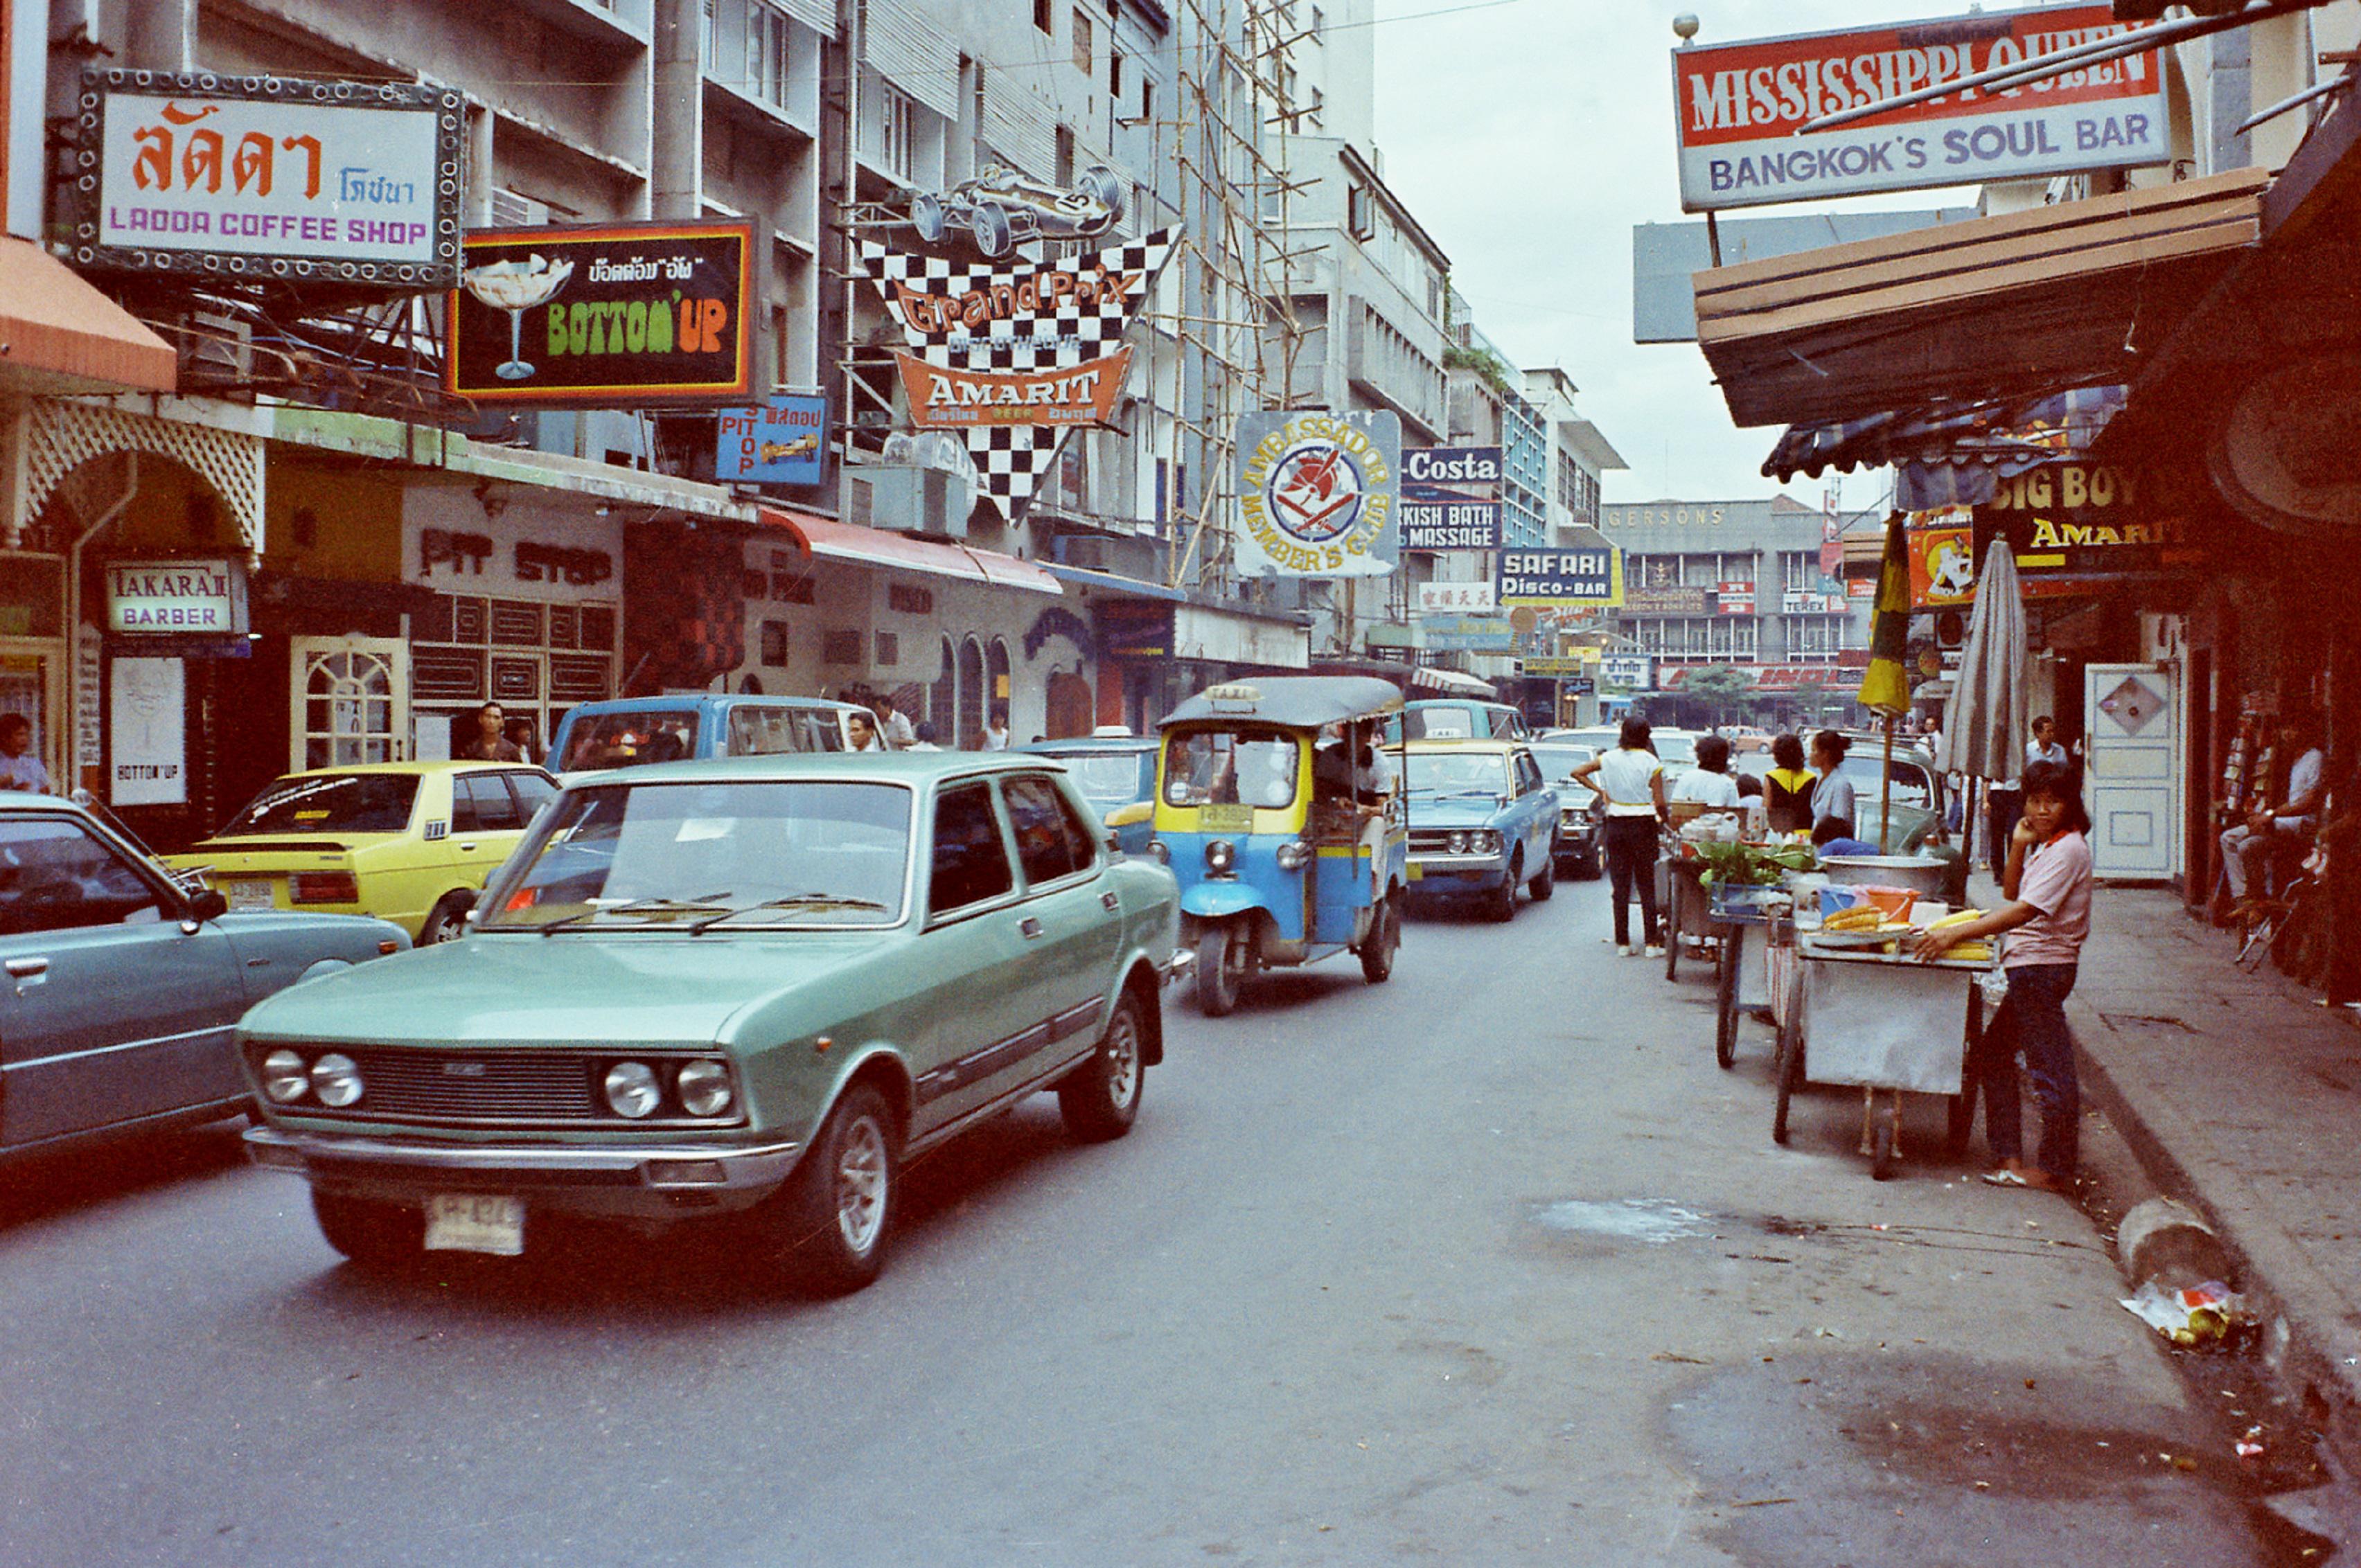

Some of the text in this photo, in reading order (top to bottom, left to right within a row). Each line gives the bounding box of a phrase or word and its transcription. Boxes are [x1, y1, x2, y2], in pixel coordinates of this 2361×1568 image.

[1688, 20, 2146, 132] MISSISSIPPI QUEEN
[132, 101, 321, 201] ลัดดา
[1710, 114, 2150, 191] BANGKOK'S SOUL BAR
[109, 206, 427, 245] LADDA COFFEE SHOP
[892, 262, 1143, 335] Grand Prix
[925, 369, 1100, 407] AMARIT
[1244, 417, 1390, 488] AMBASSADOR
[1242, 492, 1390, 571] MEMBER'S CLUB
[1399, 506, 1494, 526] KISH BATH
[1409, 527, 1494, 547] MASSAGE
[1503, 553, 1606, 576] SAFARI
[123, 608, 216, 625] BARBER
[1786, 601, 1824, 612] TEREX
[1212, 687, 1246, 700] TAXI
